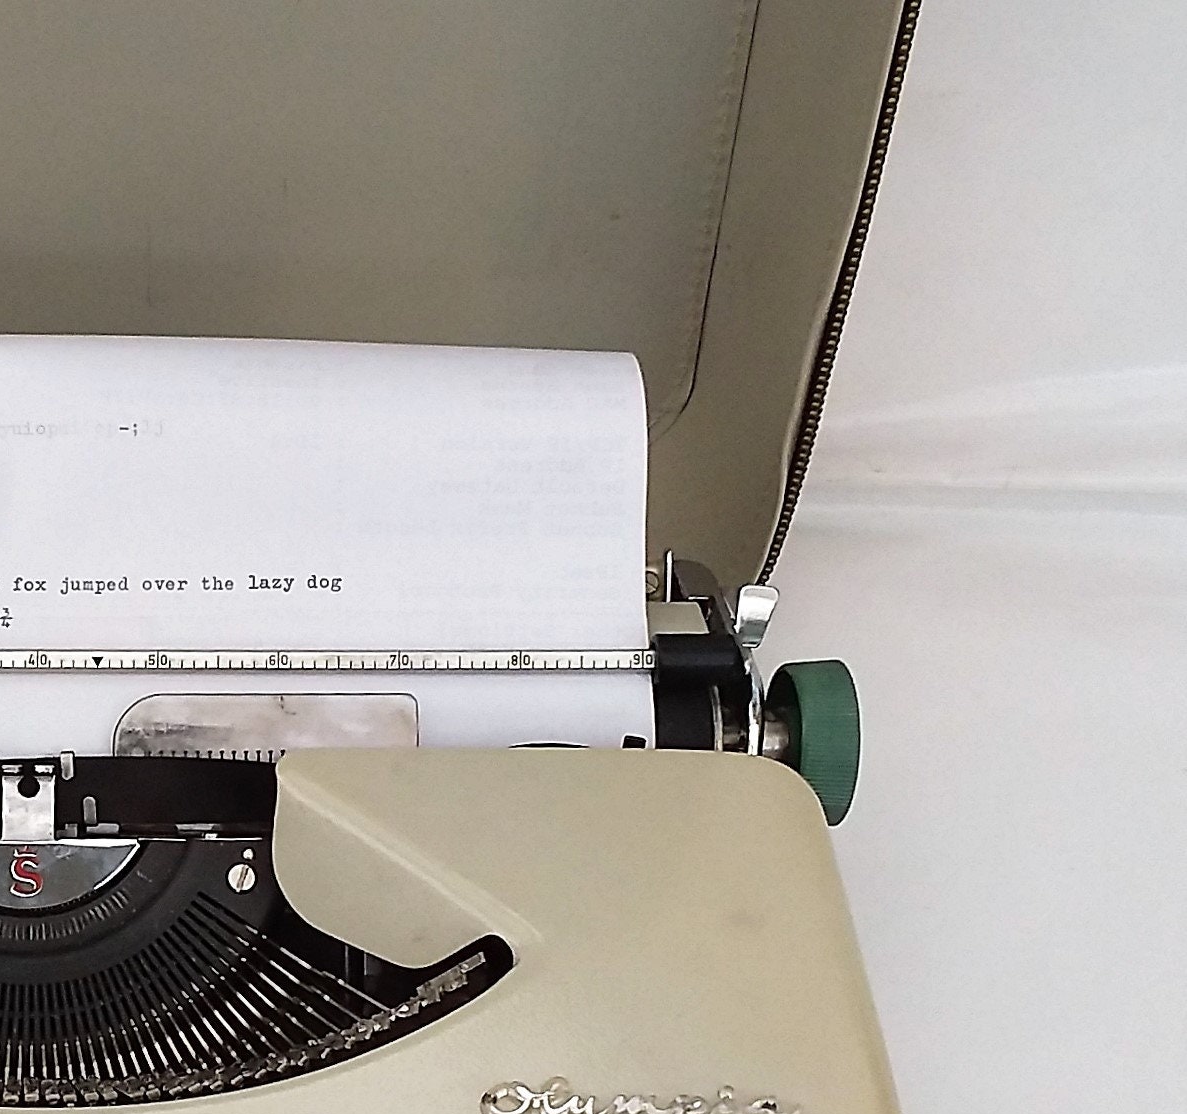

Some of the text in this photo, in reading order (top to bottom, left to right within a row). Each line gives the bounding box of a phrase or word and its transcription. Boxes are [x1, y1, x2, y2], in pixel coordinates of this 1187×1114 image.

[13, 577, 46, 591] fox
[60, 577, 129, 594] jumped
[143, 580, 188, 590] over
[202, 576, 233, 590] the
[249, 575, 294, 592] lazy
[308, 575, 342, 592] dog
[28, 653, 48, 667] 40
[148, 654, 168, 667] 50
[268, 654, 288, 667] 60
[389, 655, 409, 667] 70
[511, 655, 531, 667] 80
[633, 654, 653, 666] 90
